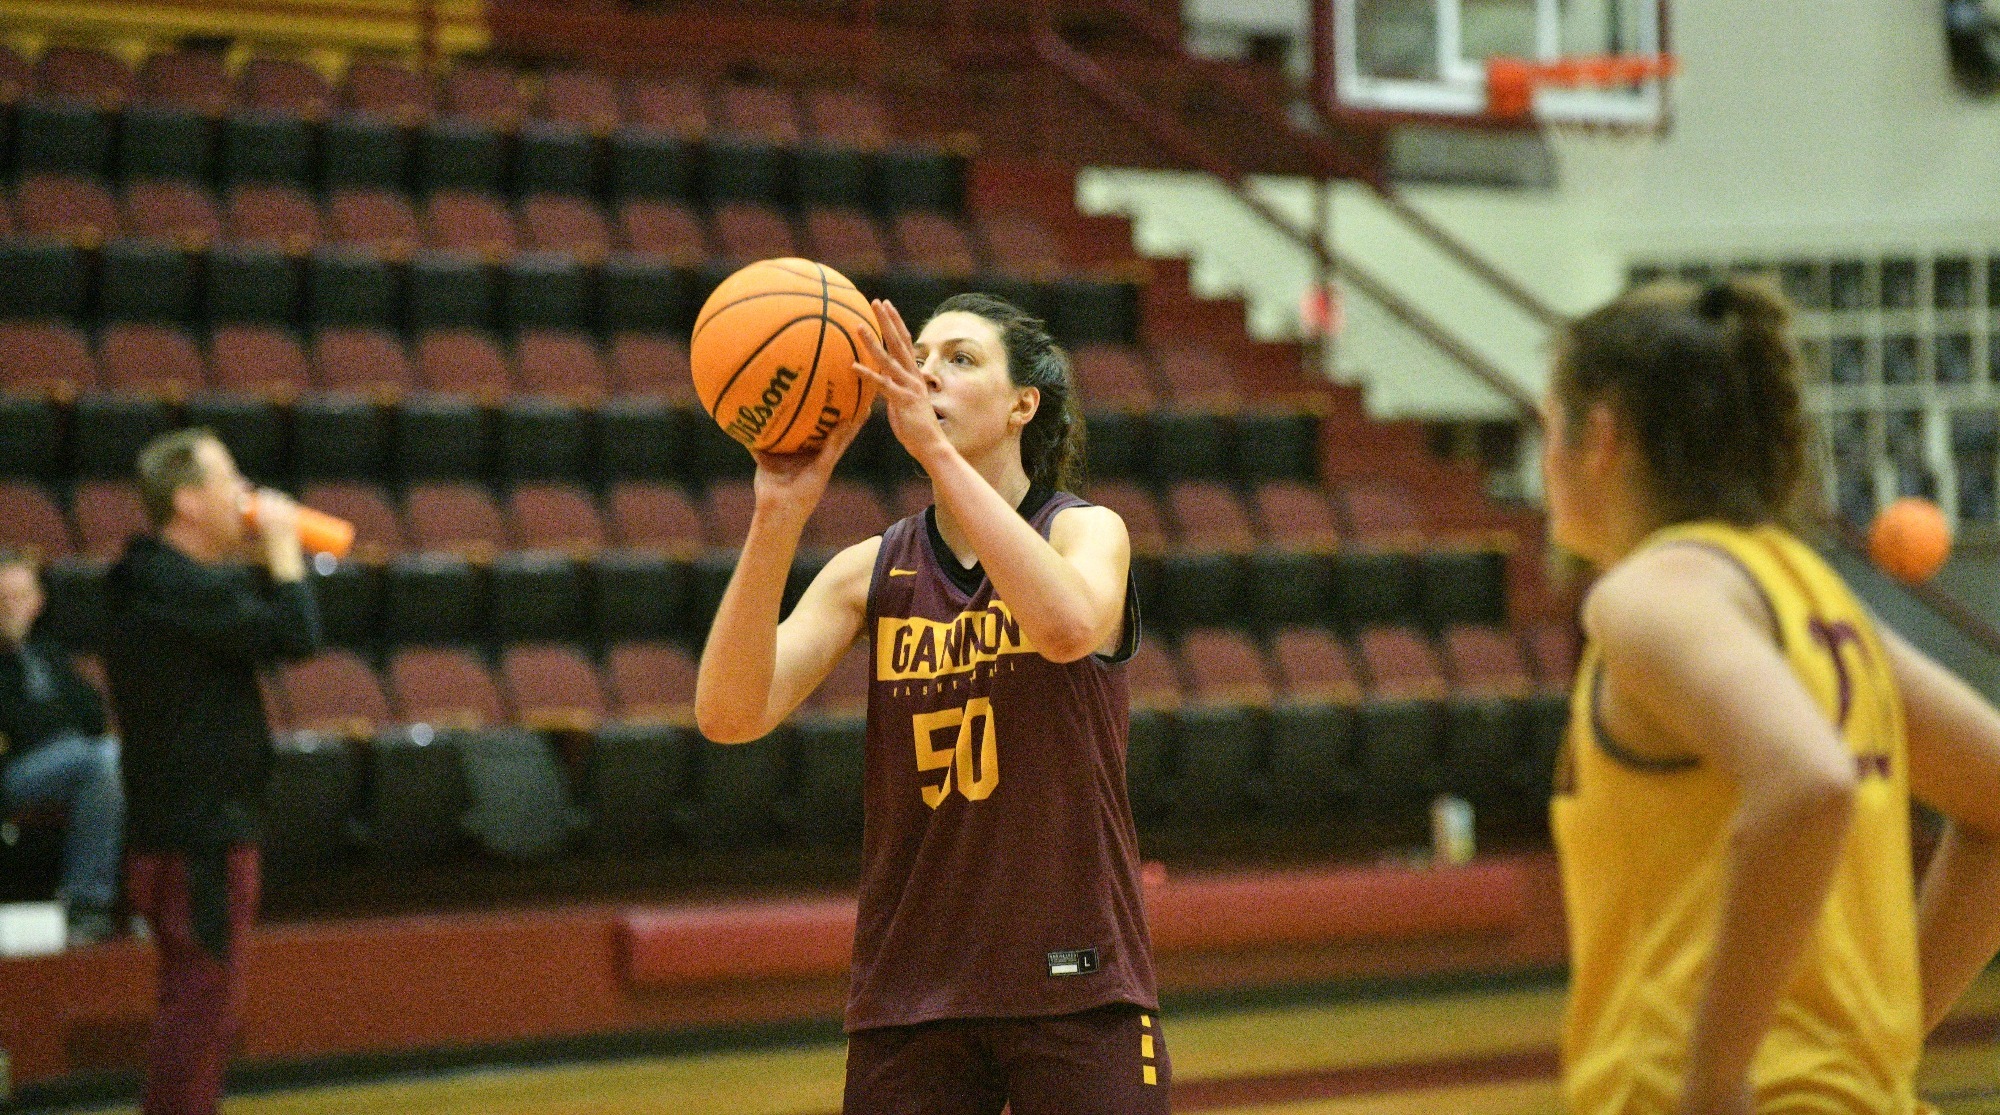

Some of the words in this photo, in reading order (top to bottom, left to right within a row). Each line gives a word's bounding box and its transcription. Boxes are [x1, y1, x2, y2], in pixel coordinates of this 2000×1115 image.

[891, 606, 1021, 674] GANNON
[912, 696, 999, 811] 50
[1084, 956, 1091, 967] L
